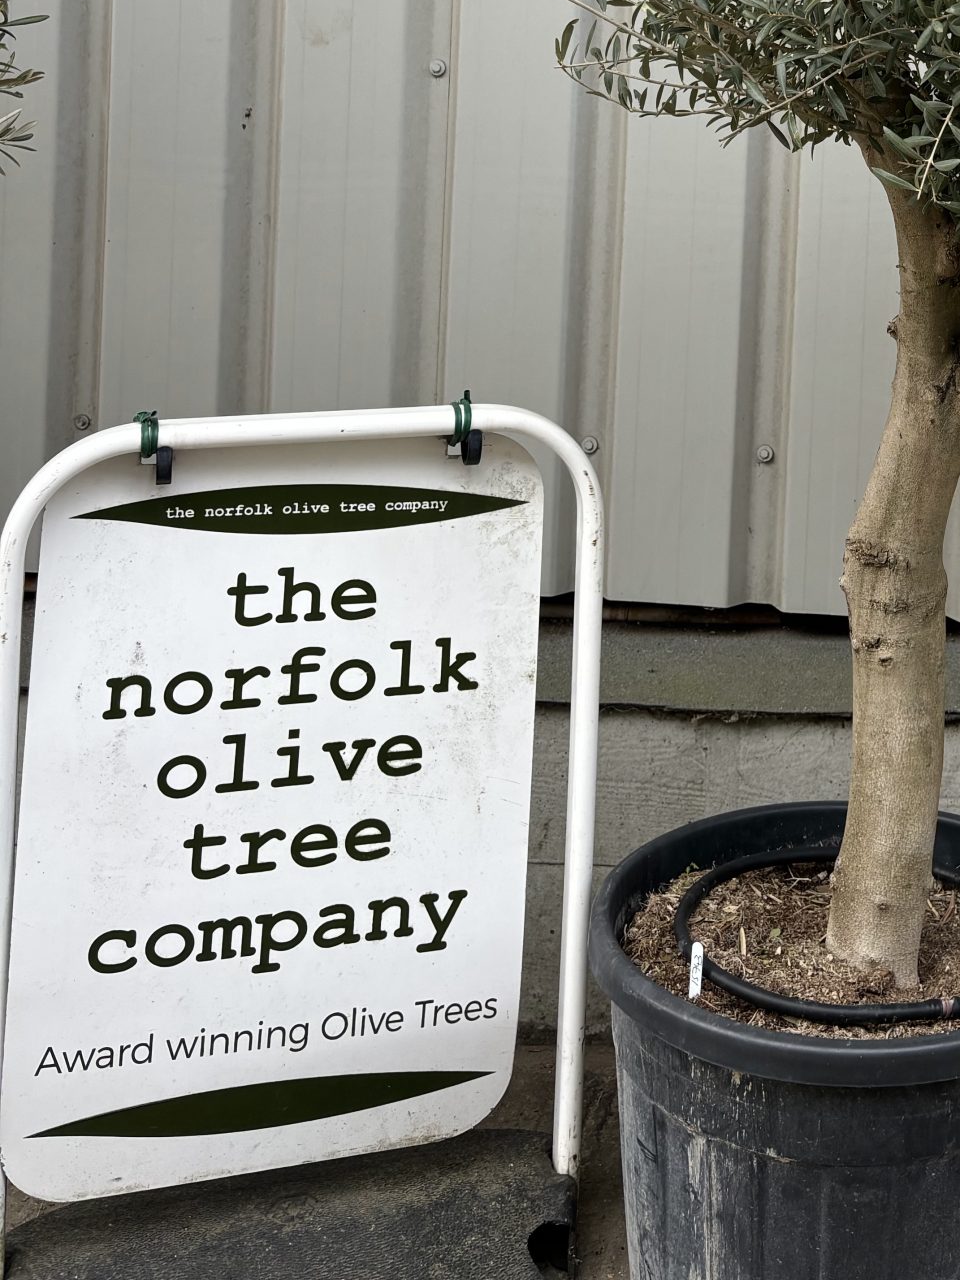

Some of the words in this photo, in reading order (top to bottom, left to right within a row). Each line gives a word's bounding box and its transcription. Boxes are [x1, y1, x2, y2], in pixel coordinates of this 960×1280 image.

[165, 506, 195, 519] the
[204, 503, 273, 518] norfolk
[282, 502, 330, 515] olive
[339, 501, 376, 513] tree
[384, 499, 449, 513] company
[227, 566, 377, 627] the
[102, 637, 479, 720] norfolk
[156, 728, 423, 799] olive
[183, 818, 392, 880] tree
[87, 889, 468, 974] company
[34, 1033, 154, 1077] Award
[166, 1020, 309, 1061] winning
[321, 1007, 404, 1041] Olive
[414, 996, 498, 1028] Trees
